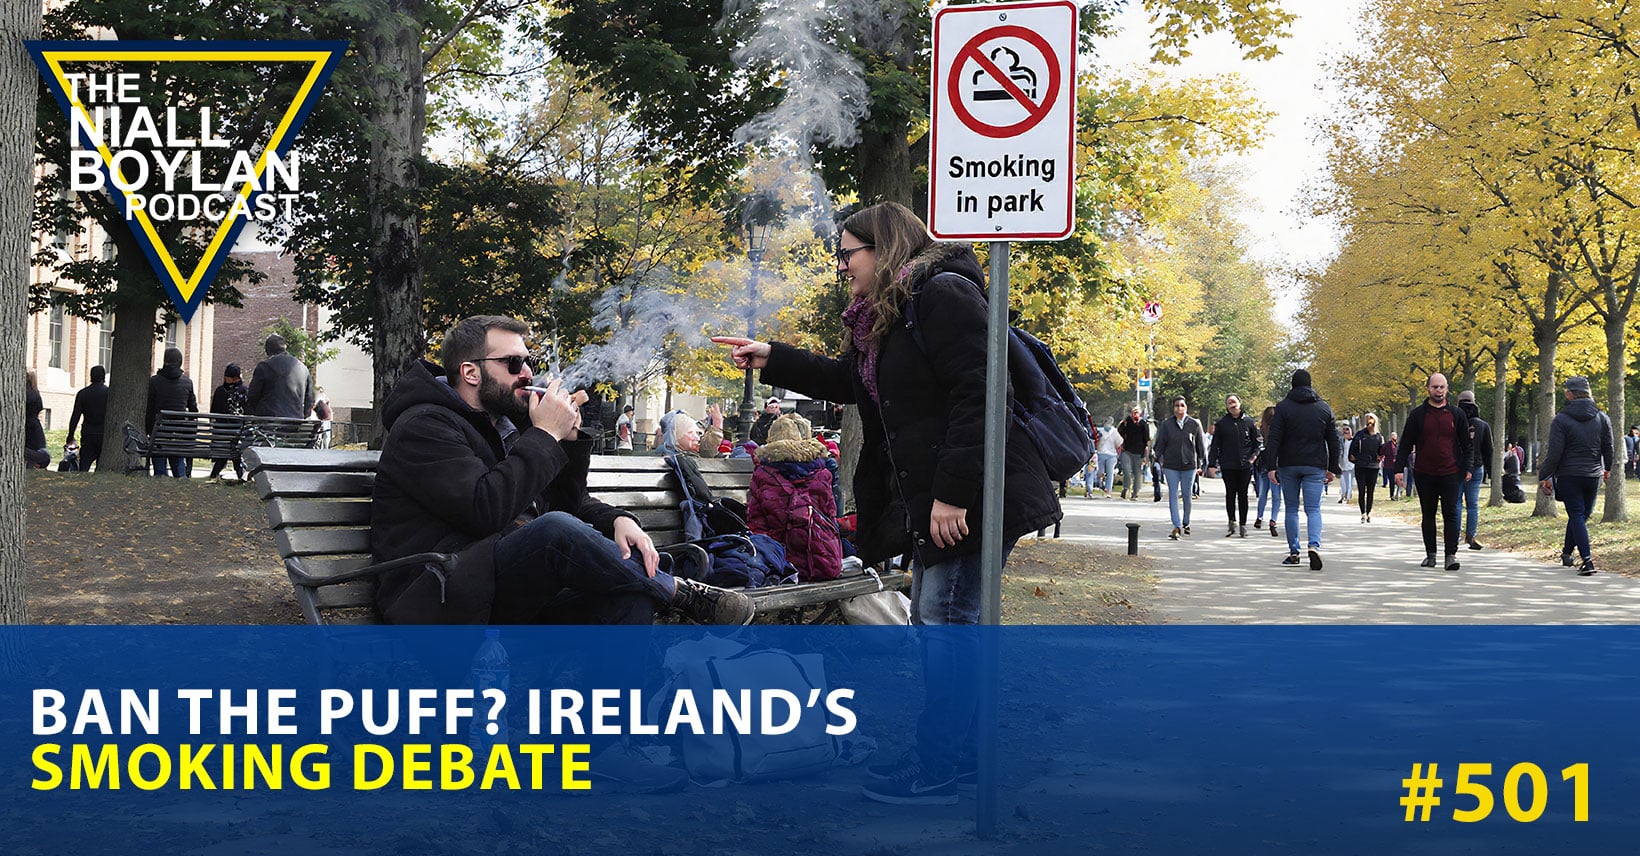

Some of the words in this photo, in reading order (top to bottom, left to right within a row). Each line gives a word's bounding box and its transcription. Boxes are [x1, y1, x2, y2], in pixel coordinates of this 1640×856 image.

[948, 154, 1055, 183] Smoking
[956, 190, 978, 213] in
[987, 189, 1044, 219] park
